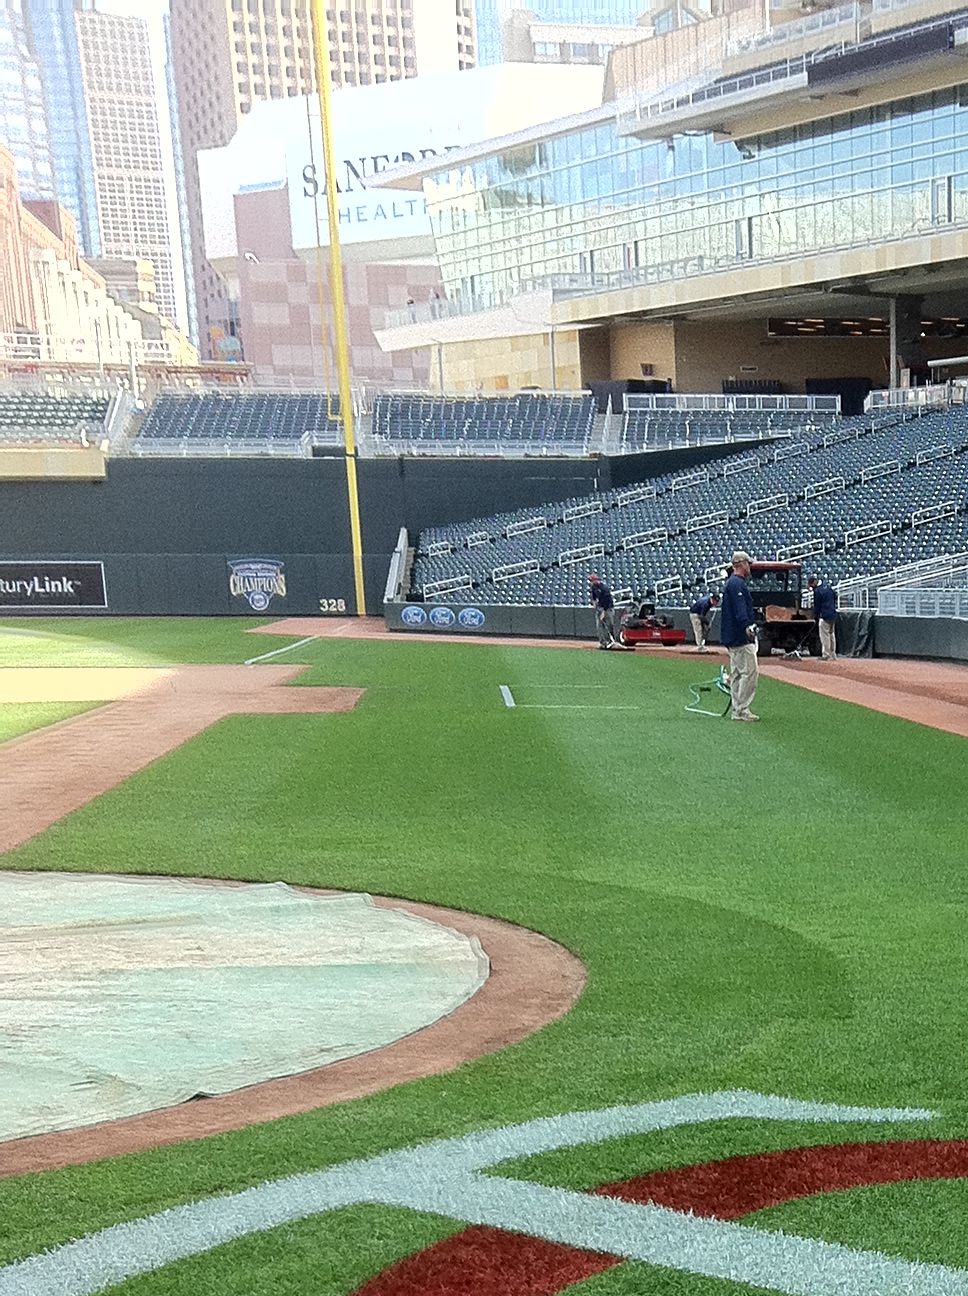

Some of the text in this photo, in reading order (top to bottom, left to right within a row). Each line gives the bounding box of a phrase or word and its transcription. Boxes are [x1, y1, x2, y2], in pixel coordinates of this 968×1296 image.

[338, 197, 429, 225] HEALT
[230, 573, 287, 598] CHAMPIONS
[320, 599, 346, 612] 328
